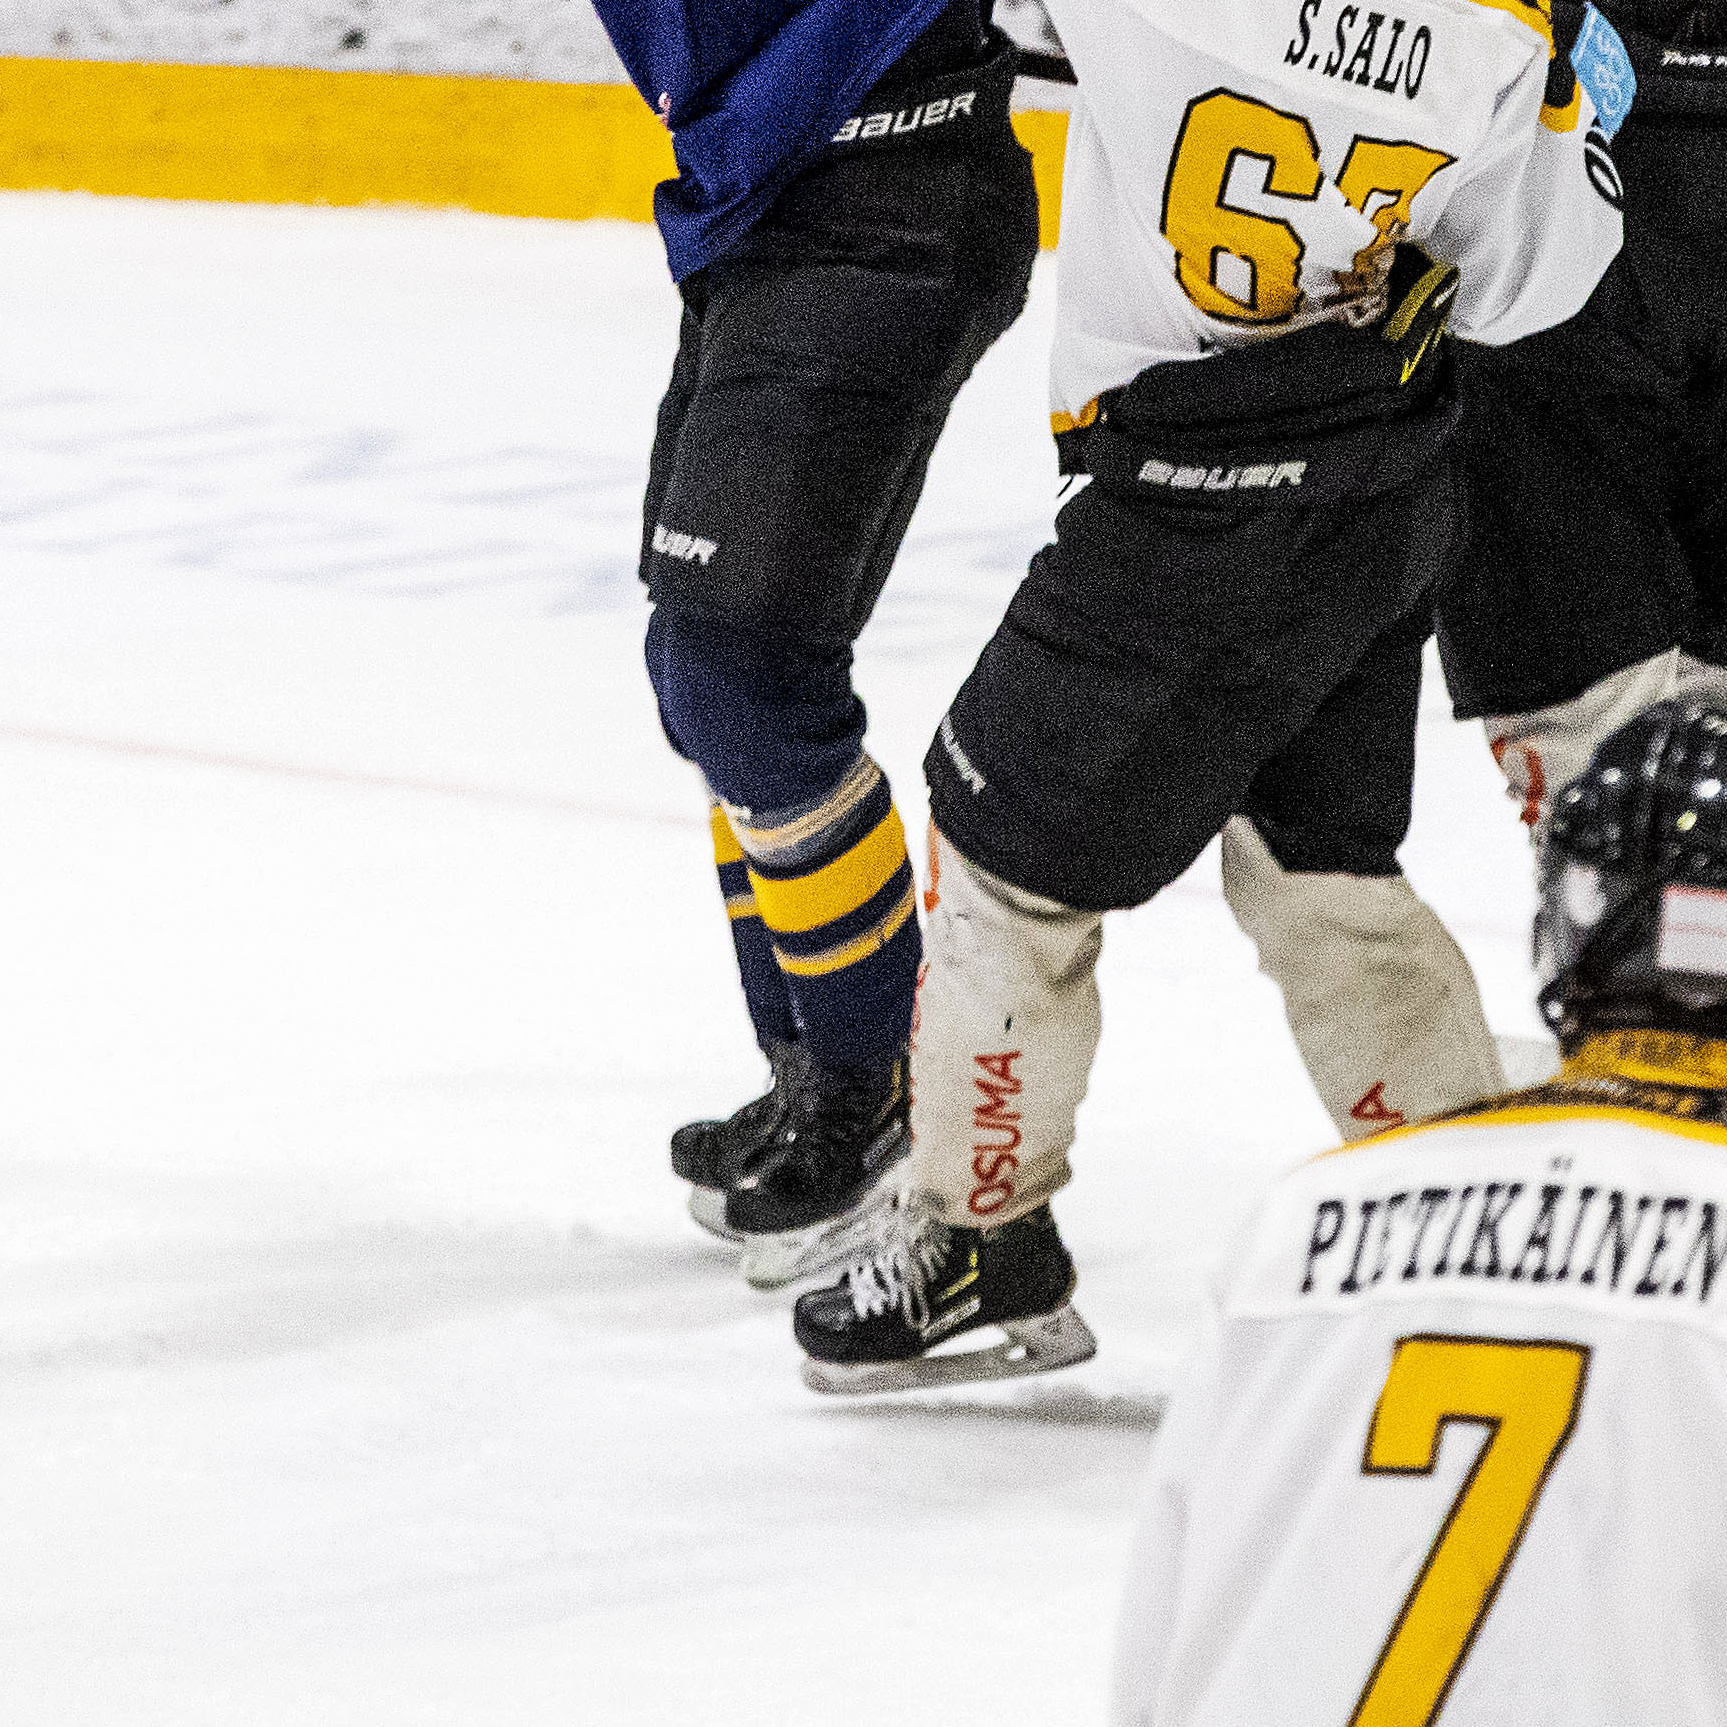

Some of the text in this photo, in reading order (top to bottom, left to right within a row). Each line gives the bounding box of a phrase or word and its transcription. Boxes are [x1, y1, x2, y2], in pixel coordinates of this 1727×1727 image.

[1159, 86, 1459, 325] 67
[968, 1049, 1022, 1217] OSUMA
[1360, 1333, 1593, 1727] 7
